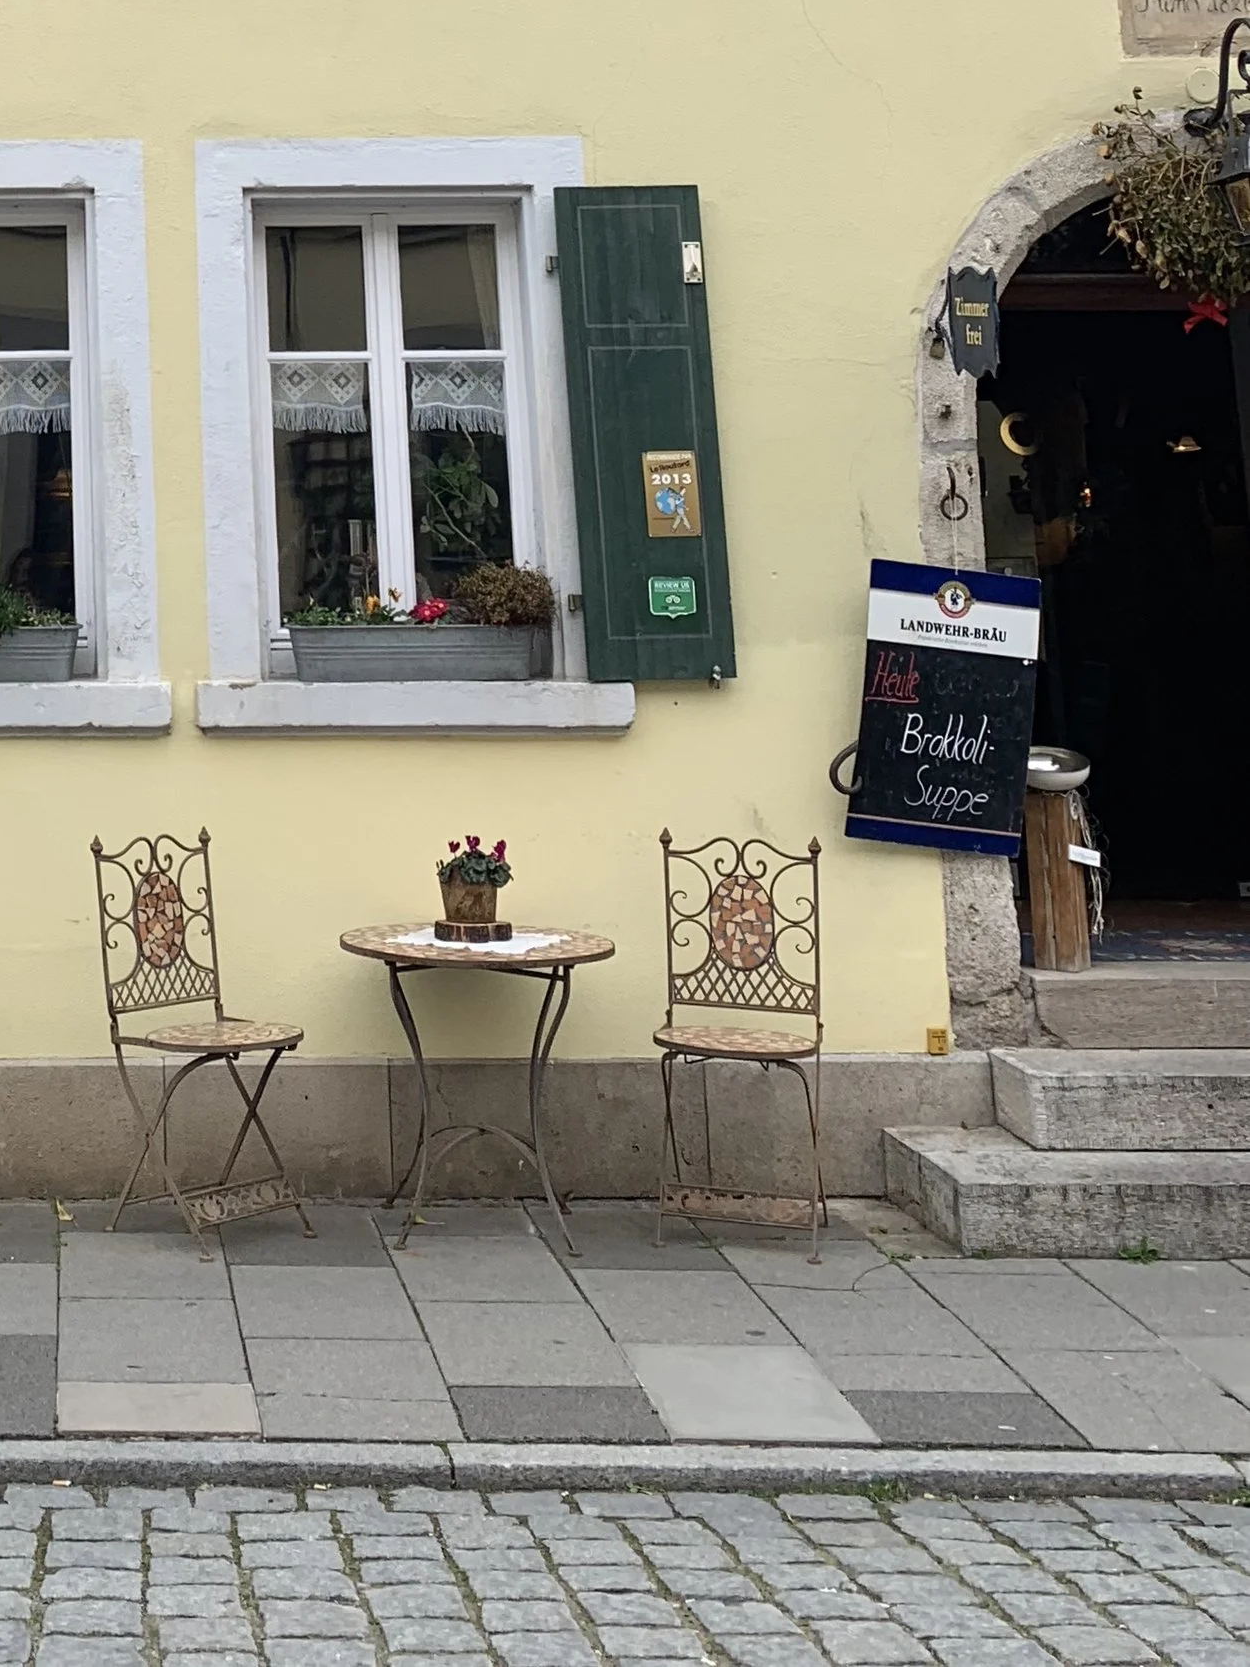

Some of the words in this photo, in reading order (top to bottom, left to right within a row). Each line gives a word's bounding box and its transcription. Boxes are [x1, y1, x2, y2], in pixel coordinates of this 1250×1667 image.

[954, 296, 990, 317] Zimmer
[965, 323, 983, 346] frei
[651, 473, 692, 485] 2013
[900, 618, 1007, 643] LANDWEHR-BRÄU
[871, 651, 921, 699] Heute
[900, 713, 995, 765] Brokkoli-
[903, 764, 990, 822] Suppe
